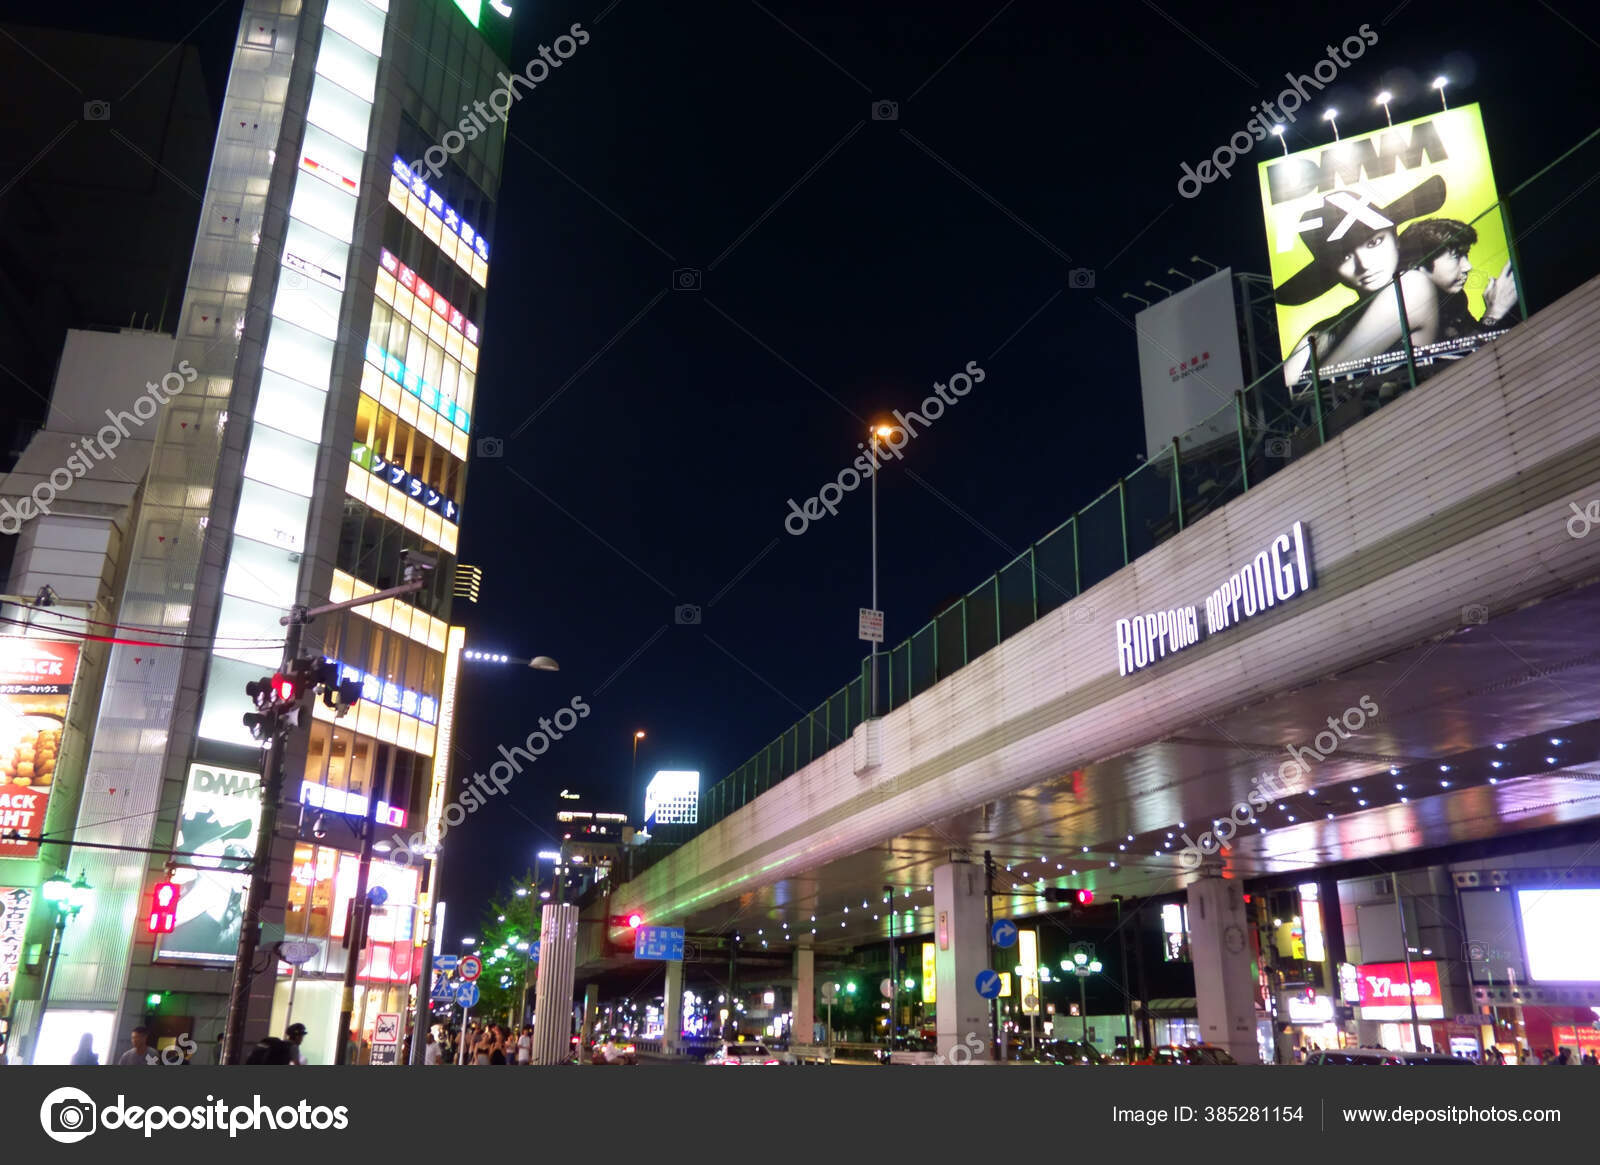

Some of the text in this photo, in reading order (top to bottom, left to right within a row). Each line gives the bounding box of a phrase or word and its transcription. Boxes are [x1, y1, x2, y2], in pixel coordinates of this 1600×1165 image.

[1267, 121, 1449, 205] DMM
[1272, 191, 1395, 254] FX
[1116, 520, 1309, 677] ROPPONGI ROPPONGI
